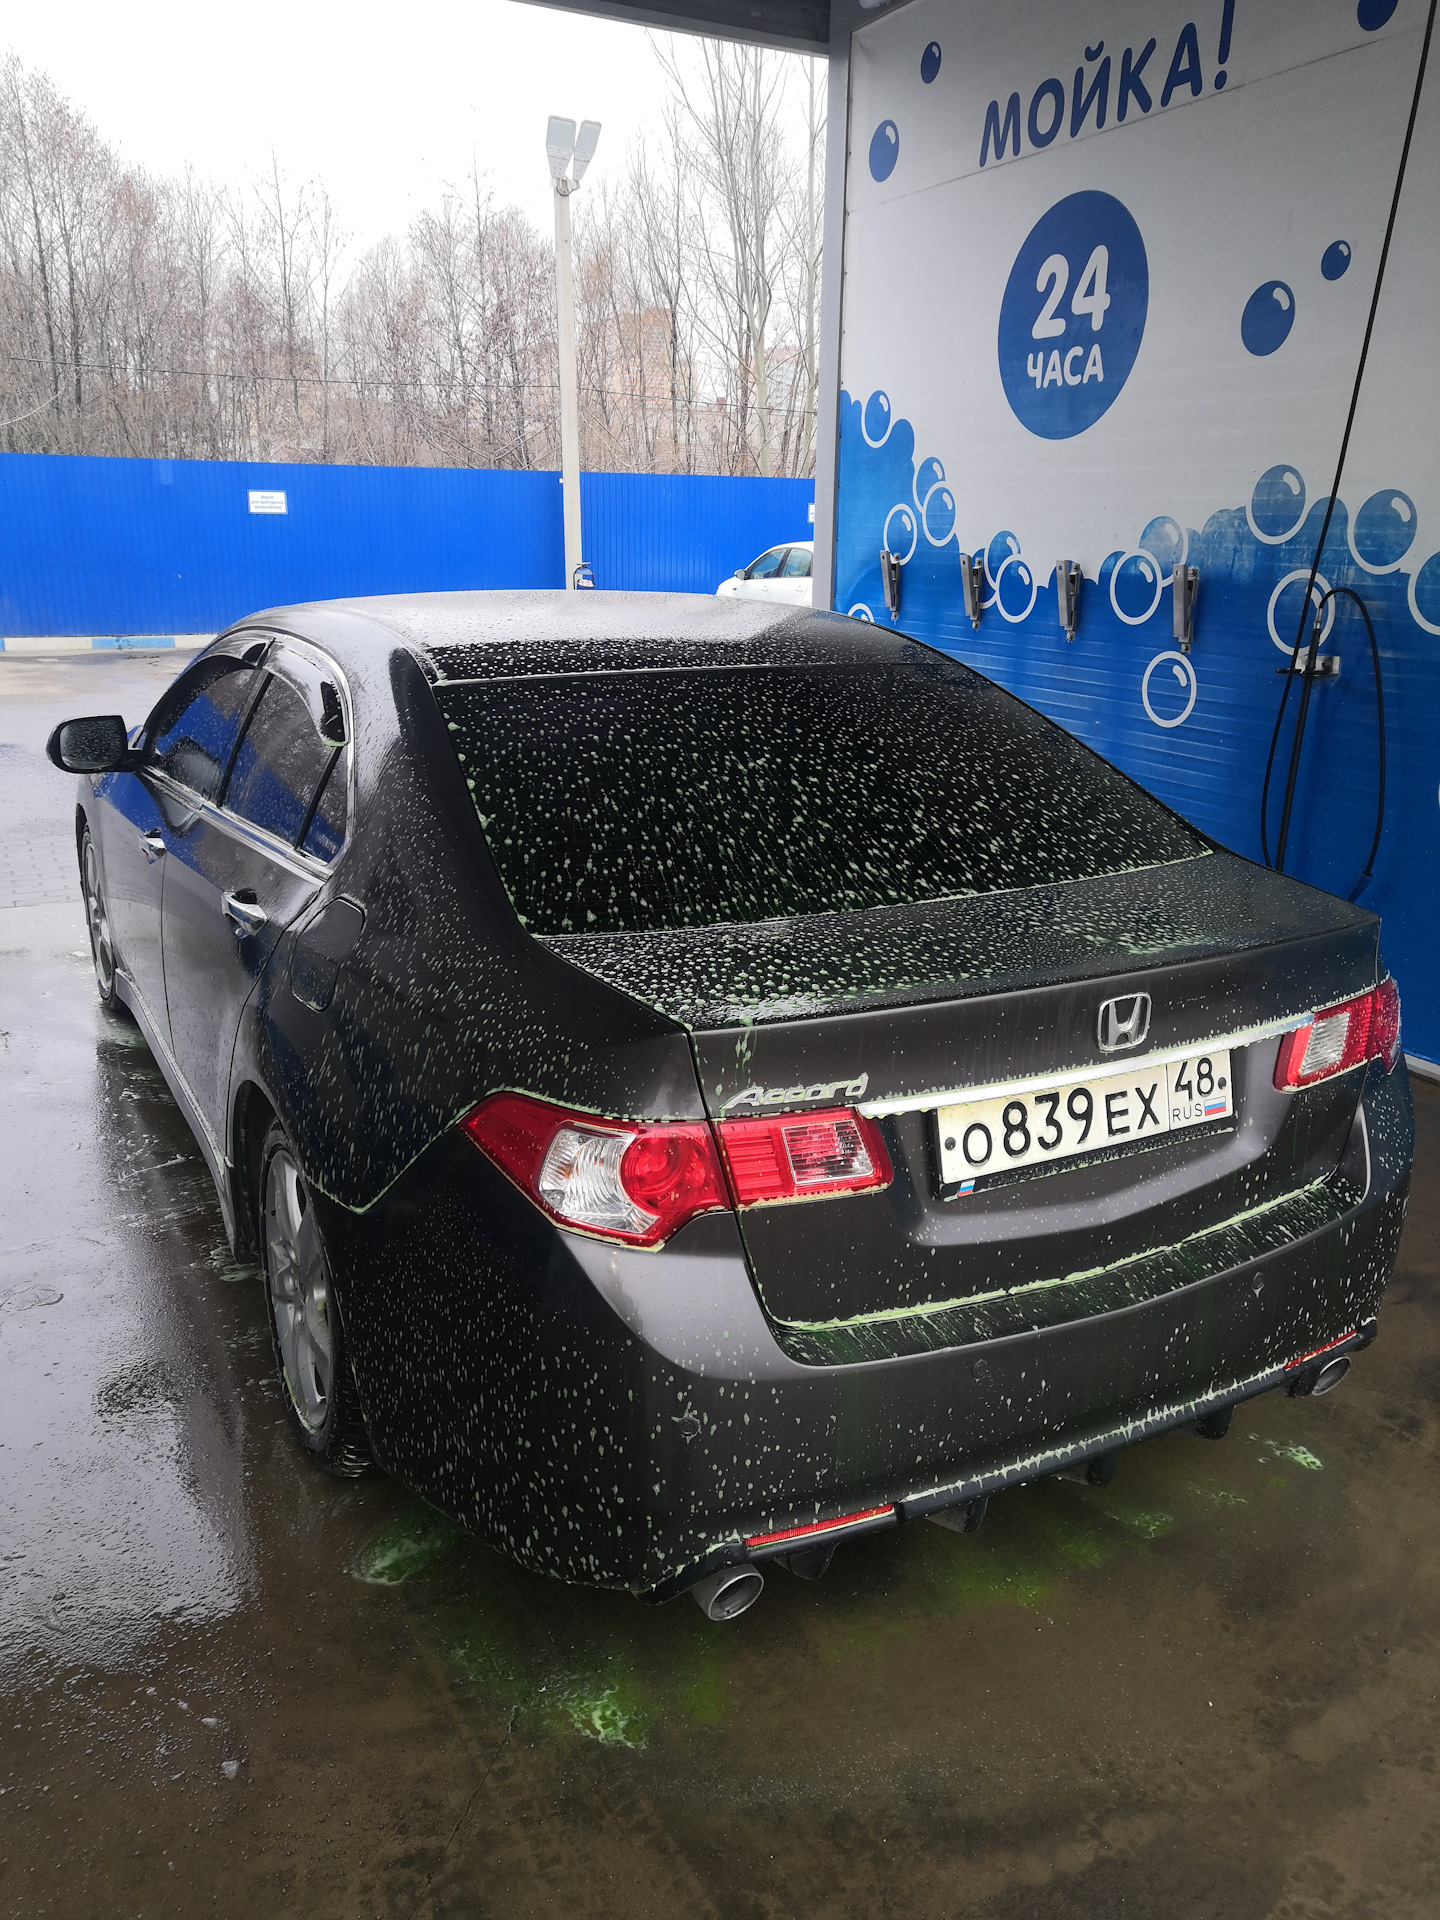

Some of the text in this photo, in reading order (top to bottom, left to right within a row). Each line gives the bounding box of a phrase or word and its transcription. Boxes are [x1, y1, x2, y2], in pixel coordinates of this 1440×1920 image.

[979, 0, 1235, 168] МОЙКА!
[1031, 244, 1111, 340] 24
[1026, 343, 1104, 389] ЧАСА
[719, 1072, 869, 1110] Accord
[1174, 1057, 1214, 1101] 48
[1172, 1104, 1203, 1123] RUS
